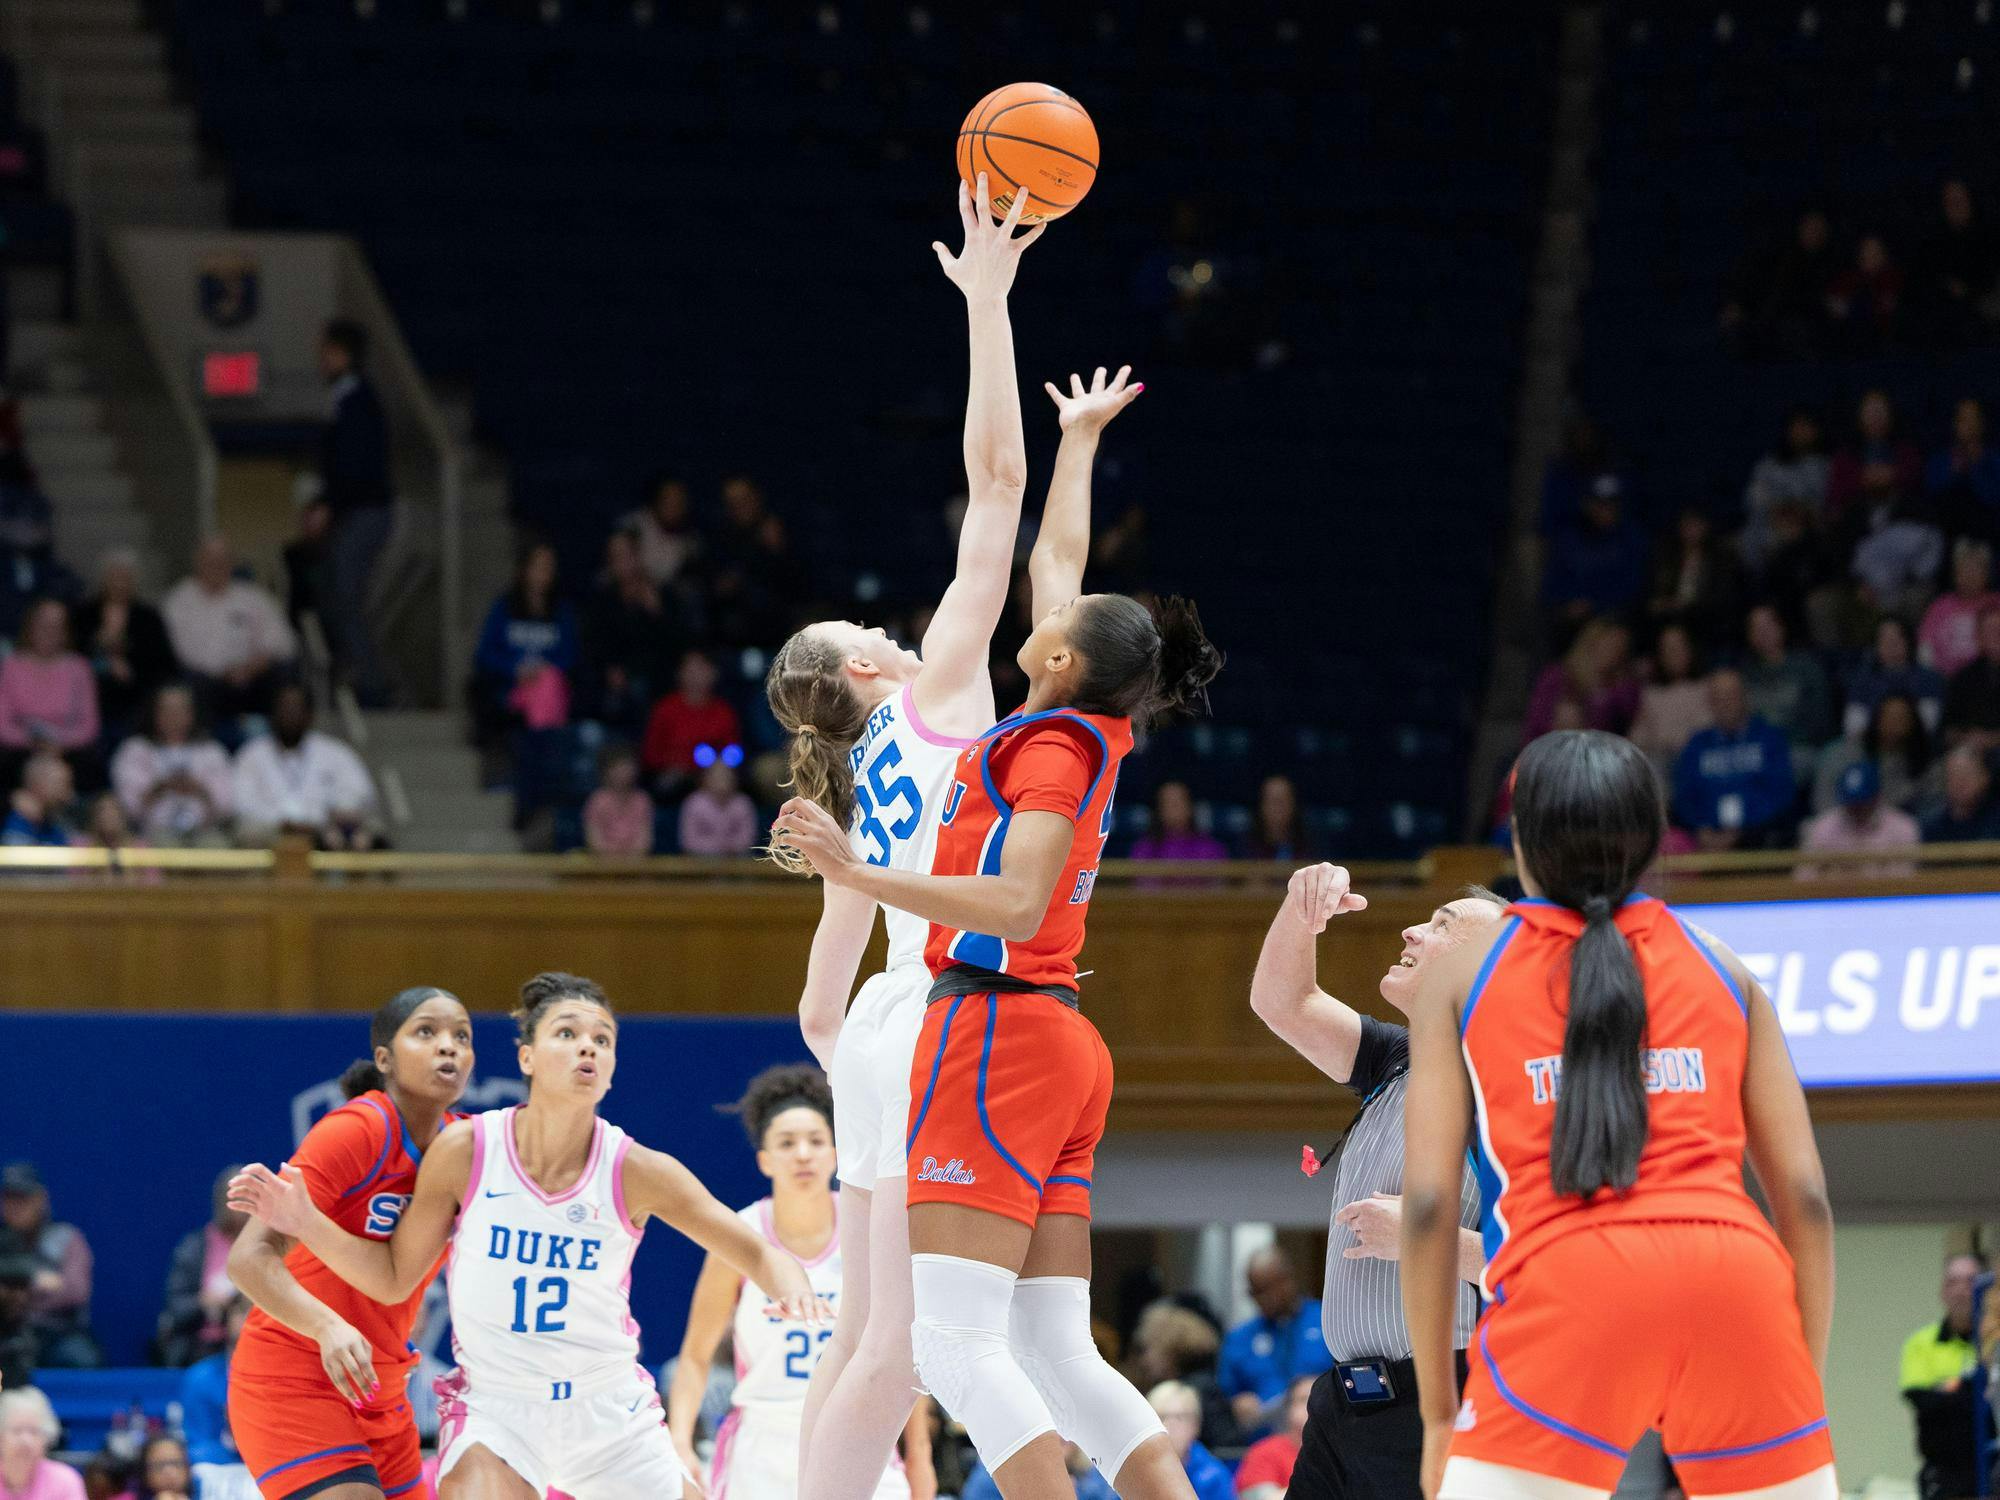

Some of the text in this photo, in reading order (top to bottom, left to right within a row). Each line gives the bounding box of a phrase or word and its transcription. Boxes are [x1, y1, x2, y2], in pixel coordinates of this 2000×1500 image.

[849, 739, 923, 867] 35
[1900, 945, 2000, 1032] UP
[917, 1156, 976, 1185] Dallas
[488, 1224, 601, 1271] DUKE
[511, 1276, 569, 1333] 12
